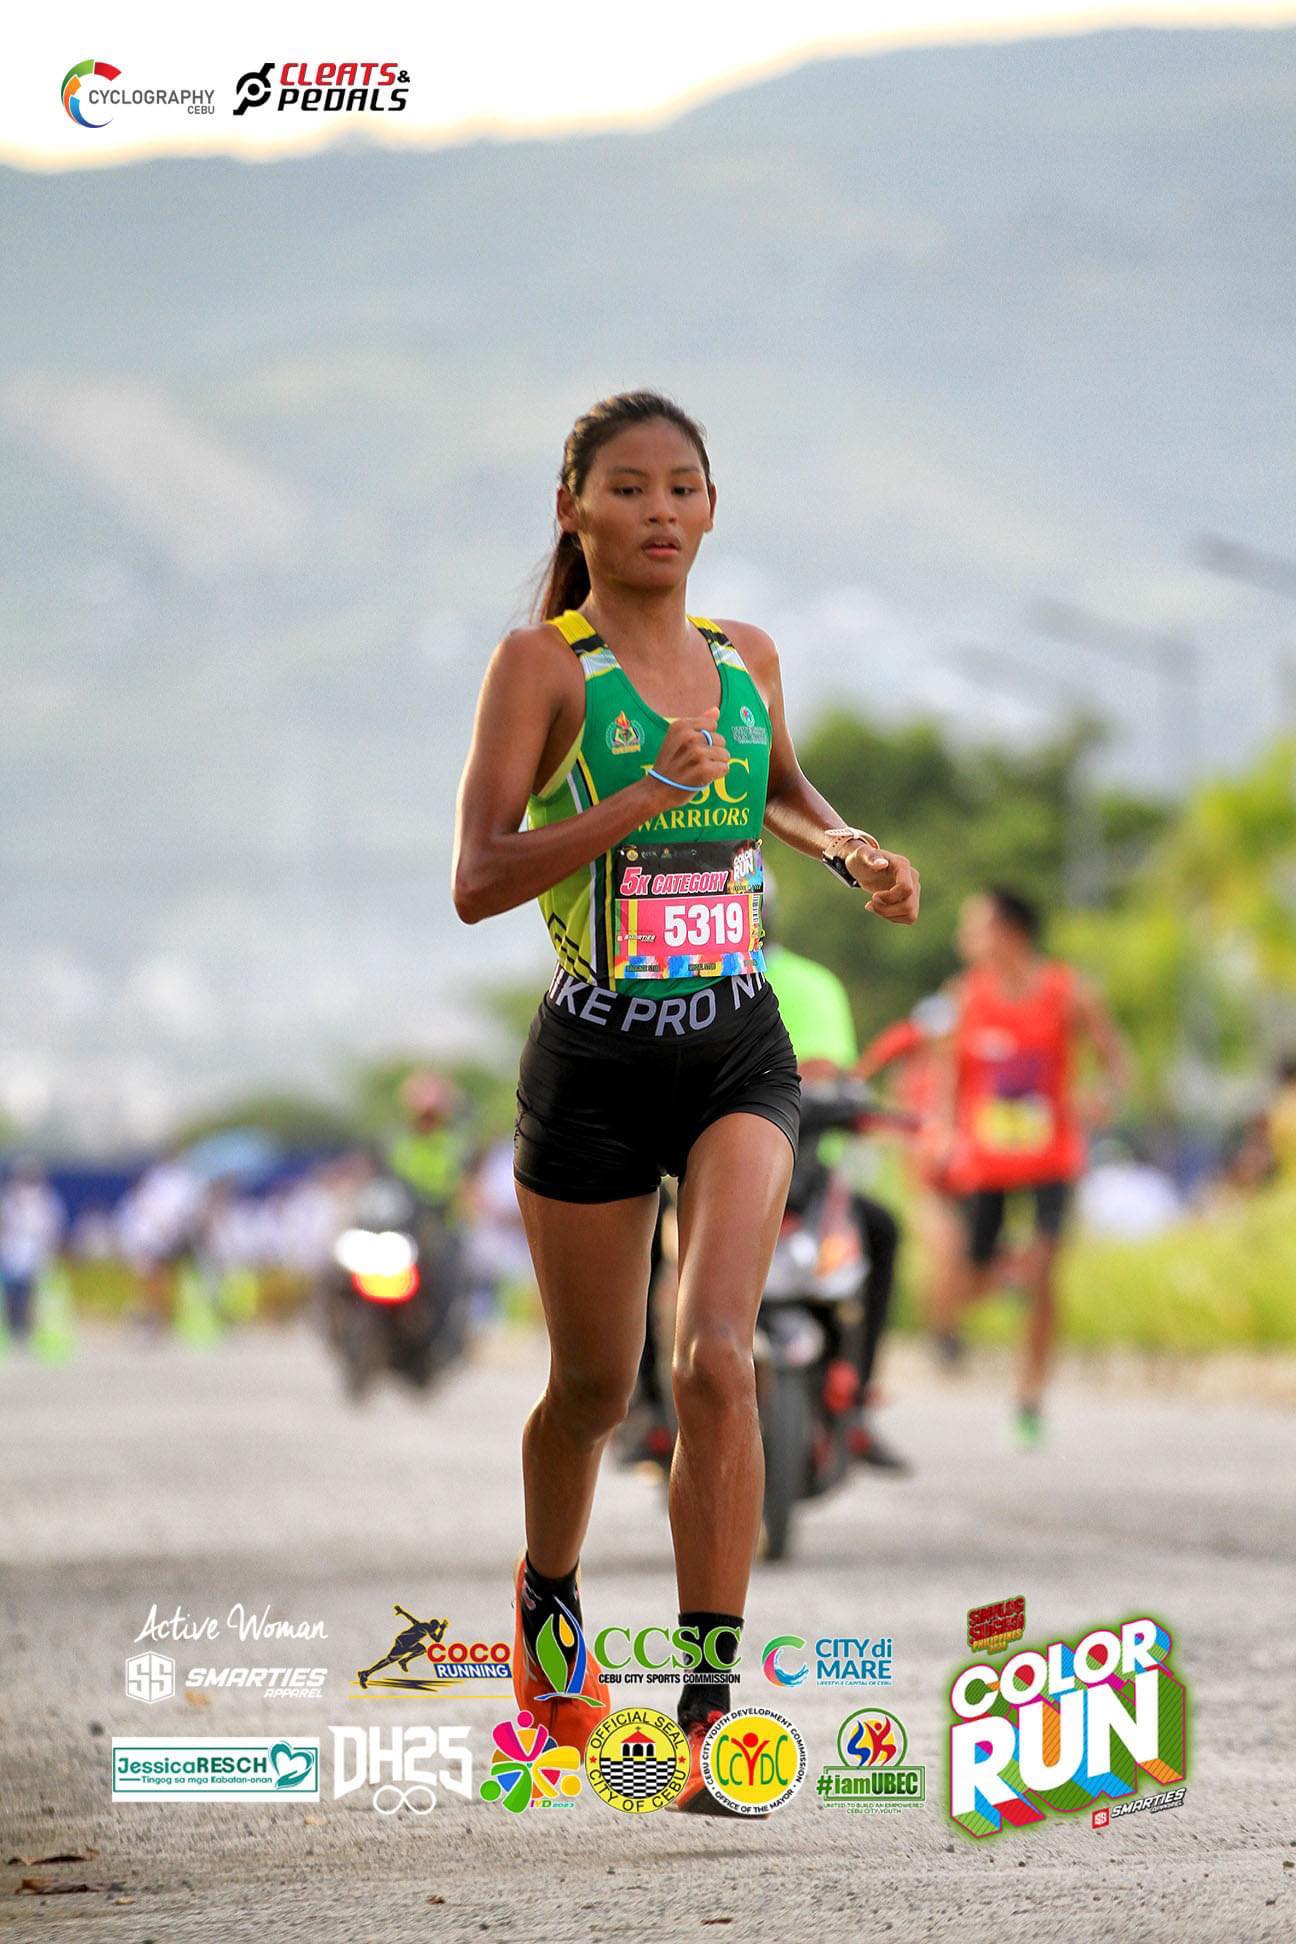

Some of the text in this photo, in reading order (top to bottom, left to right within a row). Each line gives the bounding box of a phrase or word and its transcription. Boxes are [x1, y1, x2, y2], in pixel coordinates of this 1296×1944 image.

[620, 867, 729, 896] 5K CATEGORY
[664, 902, 744, 947] 5319
[621, 989, 716, 1037] PRO
